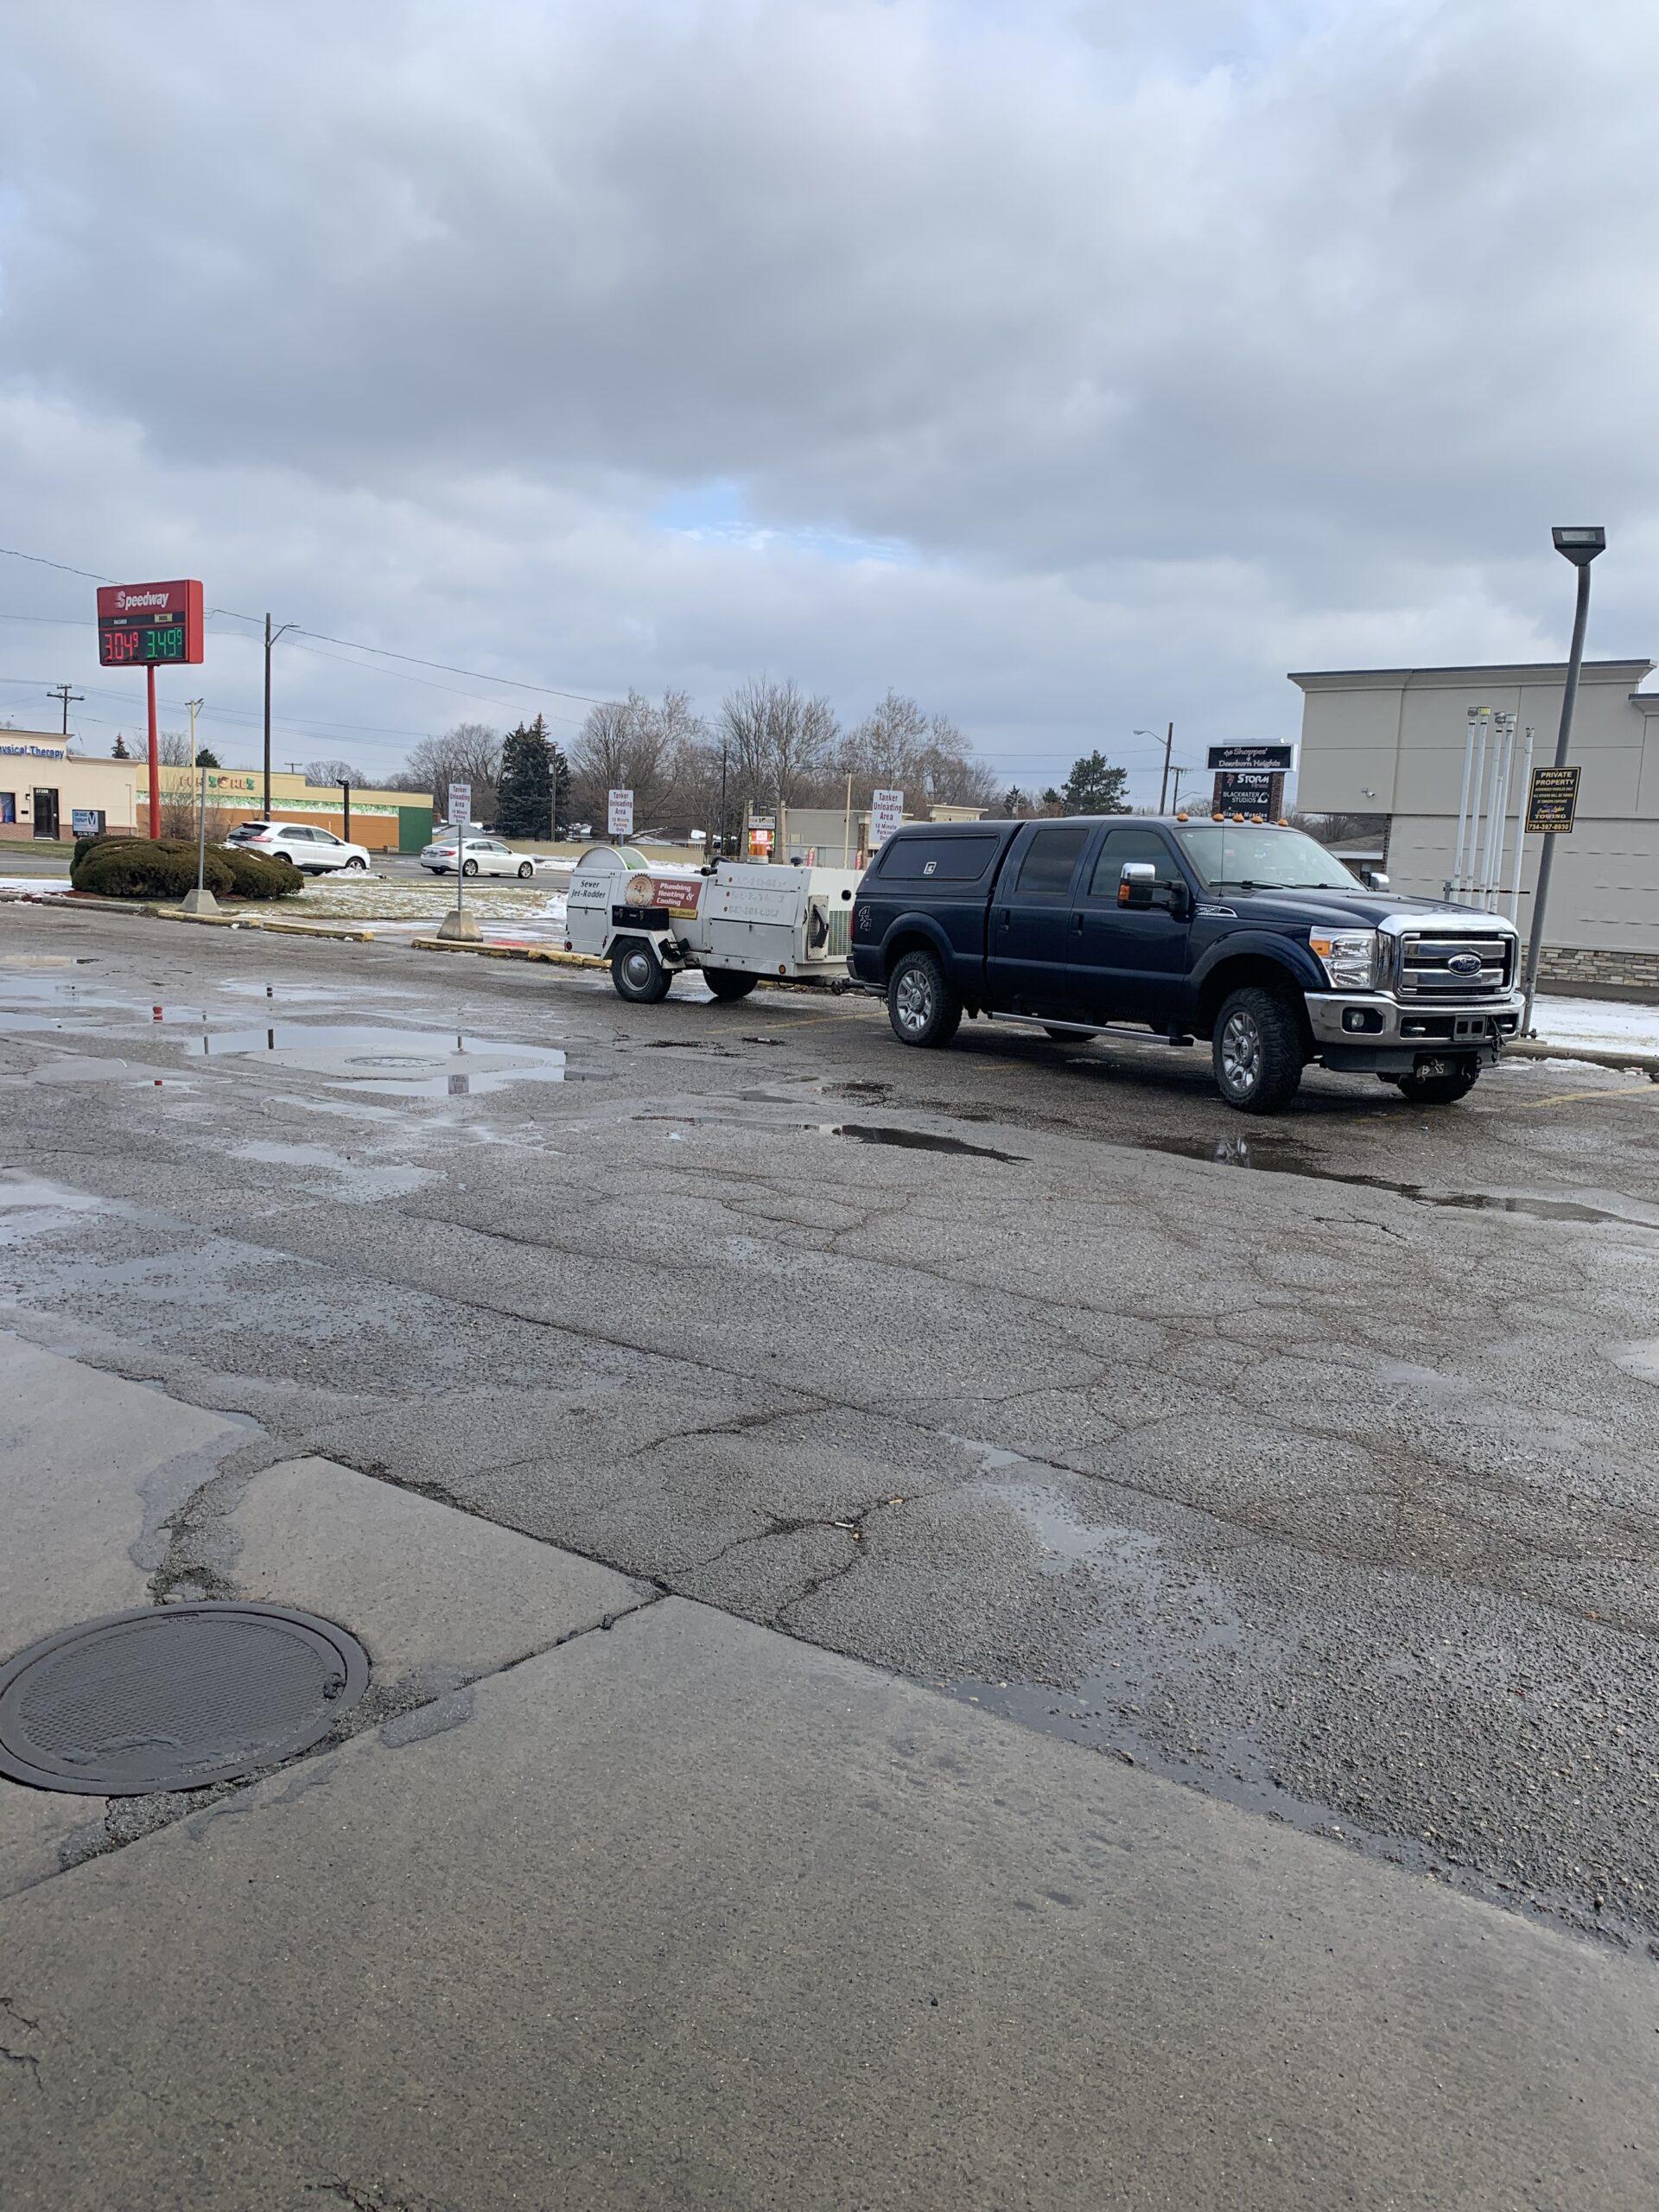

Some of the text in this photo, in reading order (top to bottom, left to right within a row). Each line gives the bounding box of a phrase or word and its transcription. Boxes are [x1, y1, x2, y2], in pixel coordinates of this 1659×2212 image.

[115, 590, 169, 611] Speedway
[0, 744, 64, 759] ysical Therapy
[1253, 760, 1281, 768] Heights
[450, 793, 471, 802] Unloading
[879, 792, 899, 802] Tanker
[609, 800, 632, 809] Unloading
[874, 802, 902, 813] Unloading
[880, 811, 893, 821] Area
[580, 880, 600, 888] Sewer
[659, 882, 692, 893] Plumbing
[571, 889, 606, 899] Jet-Rodder
[658, 890, 695, 901] Heating &
[656, 897, 682, 906] Cooling
[1458, 959, 1476, 970] Ford
